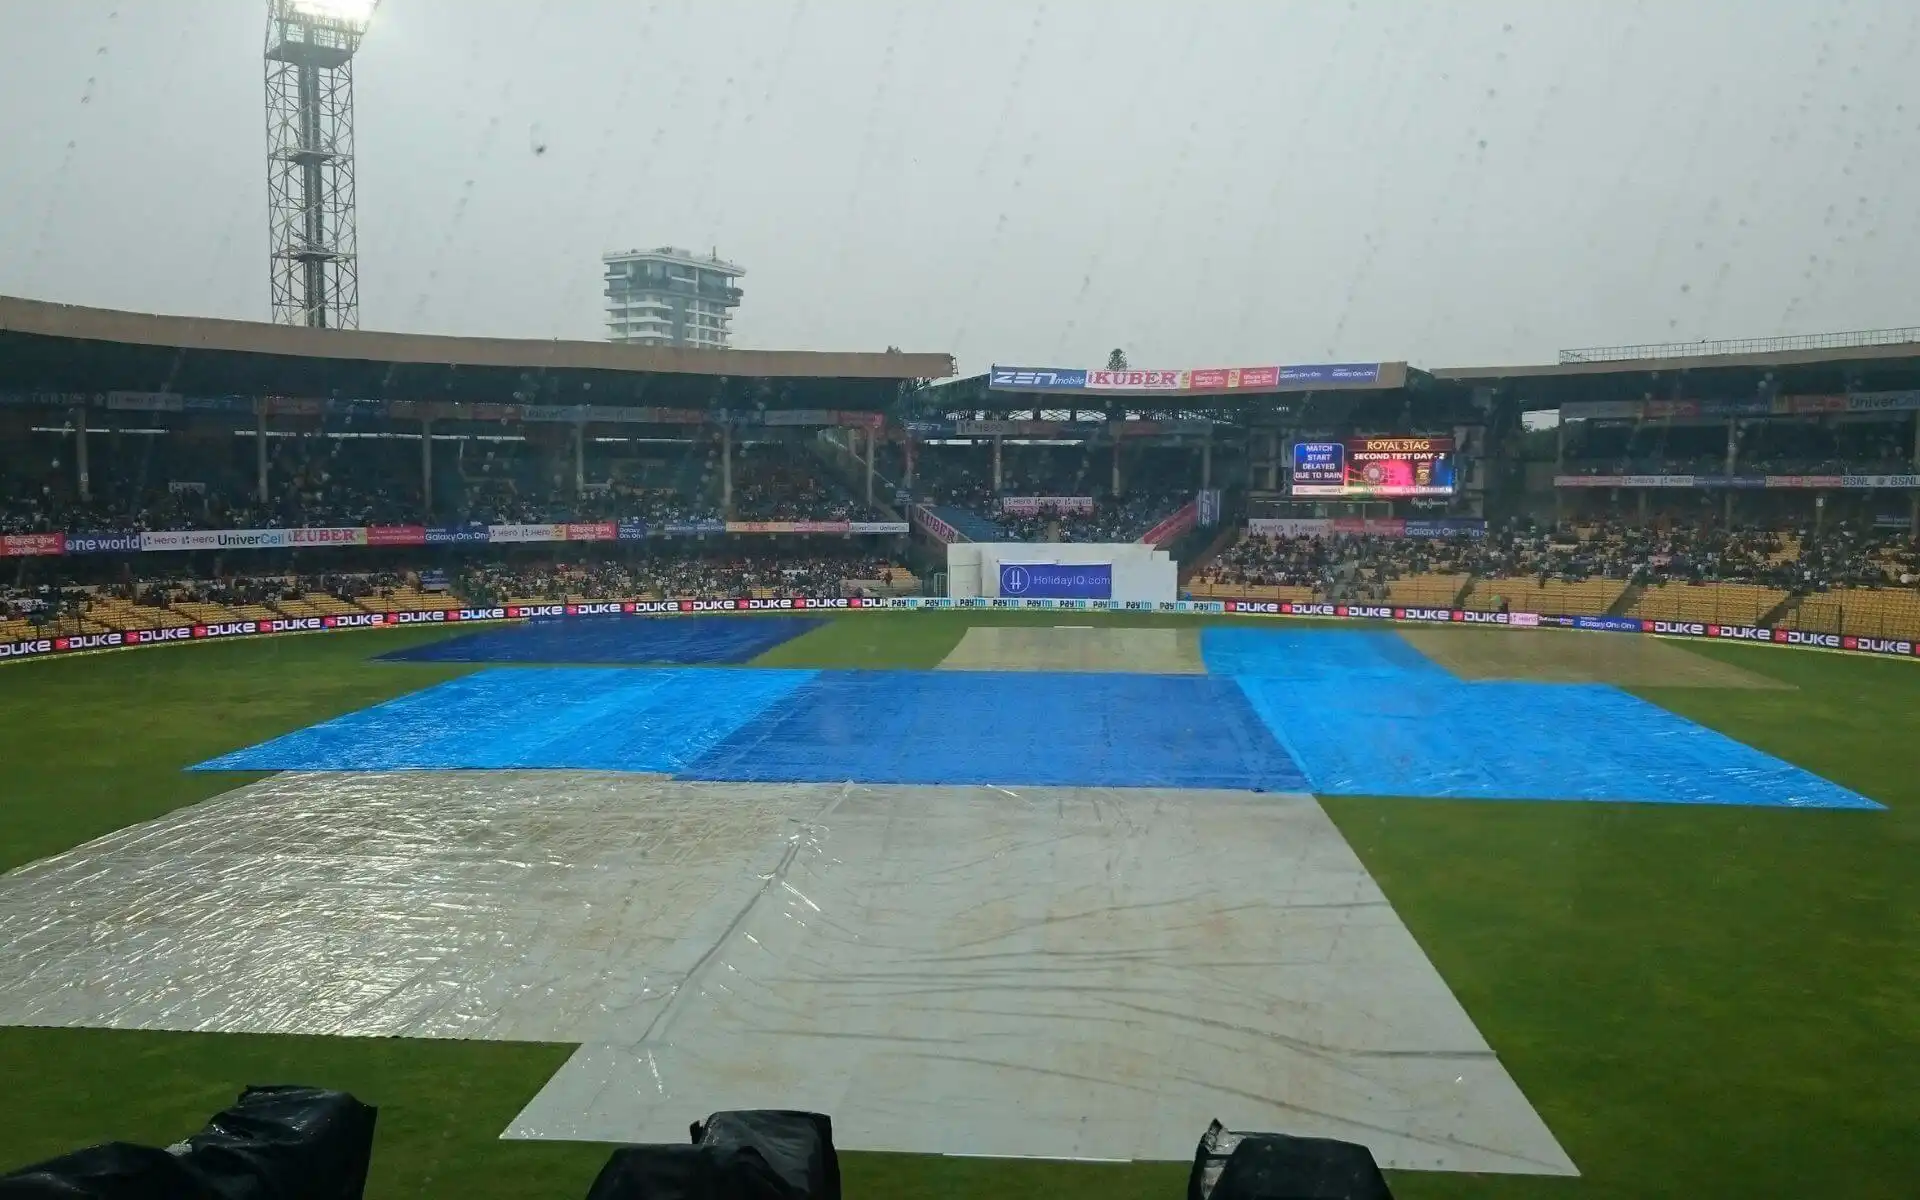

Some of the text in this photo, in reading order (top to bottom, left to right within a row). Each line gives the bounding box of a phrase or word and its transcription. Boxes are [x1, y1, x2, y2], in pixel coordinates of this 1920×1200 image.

[1055, 375, 1085, 385] mobile
[1093, 371, 1177, 385] KUBER
[1367, 441, 1430, 450] ROYAL STAG
[1891, 476, 1920, 486] BSNL
[294, 529, 355, 542] KUBER
[425, 533, 455, 543] Galaxy
[98, 535, 140, 550] world
[577, 603, 621, 614] DUKE
[635, 601, 679, 612] DUKE
[692, 600, 735, 610] DUKE
[749, 599, 792, 608] DUKE
[805, 598, 848, 608] DUKE
[1236, 602, 1278, 612] DUKE
[1292, 604, 1334, 614] DUKE
[399, 611, 445, 623] DUKE
[459, 608, 504, 620] DUKE
[519, 605, 563, 617] DUKE
[1348, 606, 1391, 617] DUKE
[1405, 609, 1449, 620] DUKE
[1464, 611, 1508, 623] DUKE
[272, 618, 321, 632] DUKE
[336, 613, 384, 626] DUKE
[1580, 620, 1605, 629] Galaxy
[207, 621, 256, 637] DUKE
[1654, 621, 1704, 635] DUKE
[1720, 626, 1771, 640] DUKE
[69, 632, 122, 649] DUKE
[139, 627, 191, 642] DUKE
[1787, 631, 1841, 647] DUKE
[1858, 638, 1911, 654] DUKE
